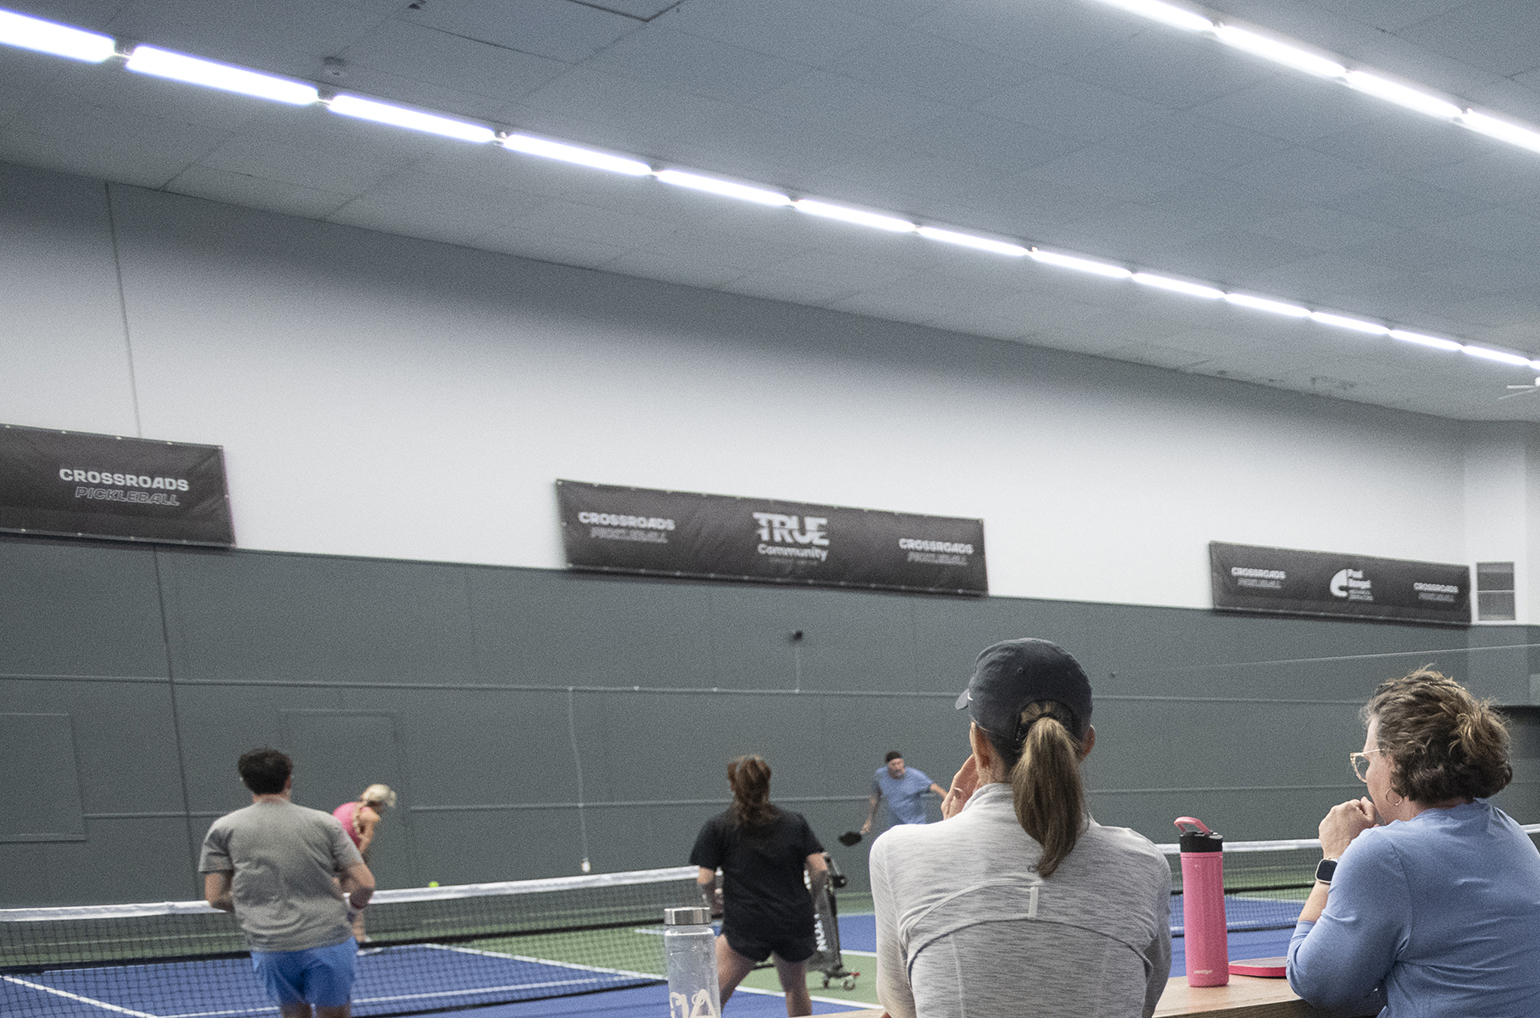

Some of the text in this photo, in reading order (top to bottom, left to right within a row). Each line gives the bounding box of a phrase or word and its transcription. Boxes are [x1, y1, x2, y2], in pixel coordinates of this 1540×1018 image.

[59, 467, 190, 492] CROSSROADS
[75, 486, 181, 507] PICKLEBALL
[578, 511, 676, 531] CROSSROADS
[752, 512, 829, 546] TRUE
[757, 543, 829, 563] Community
[898, 537, 975, 556] CROSSROADS
